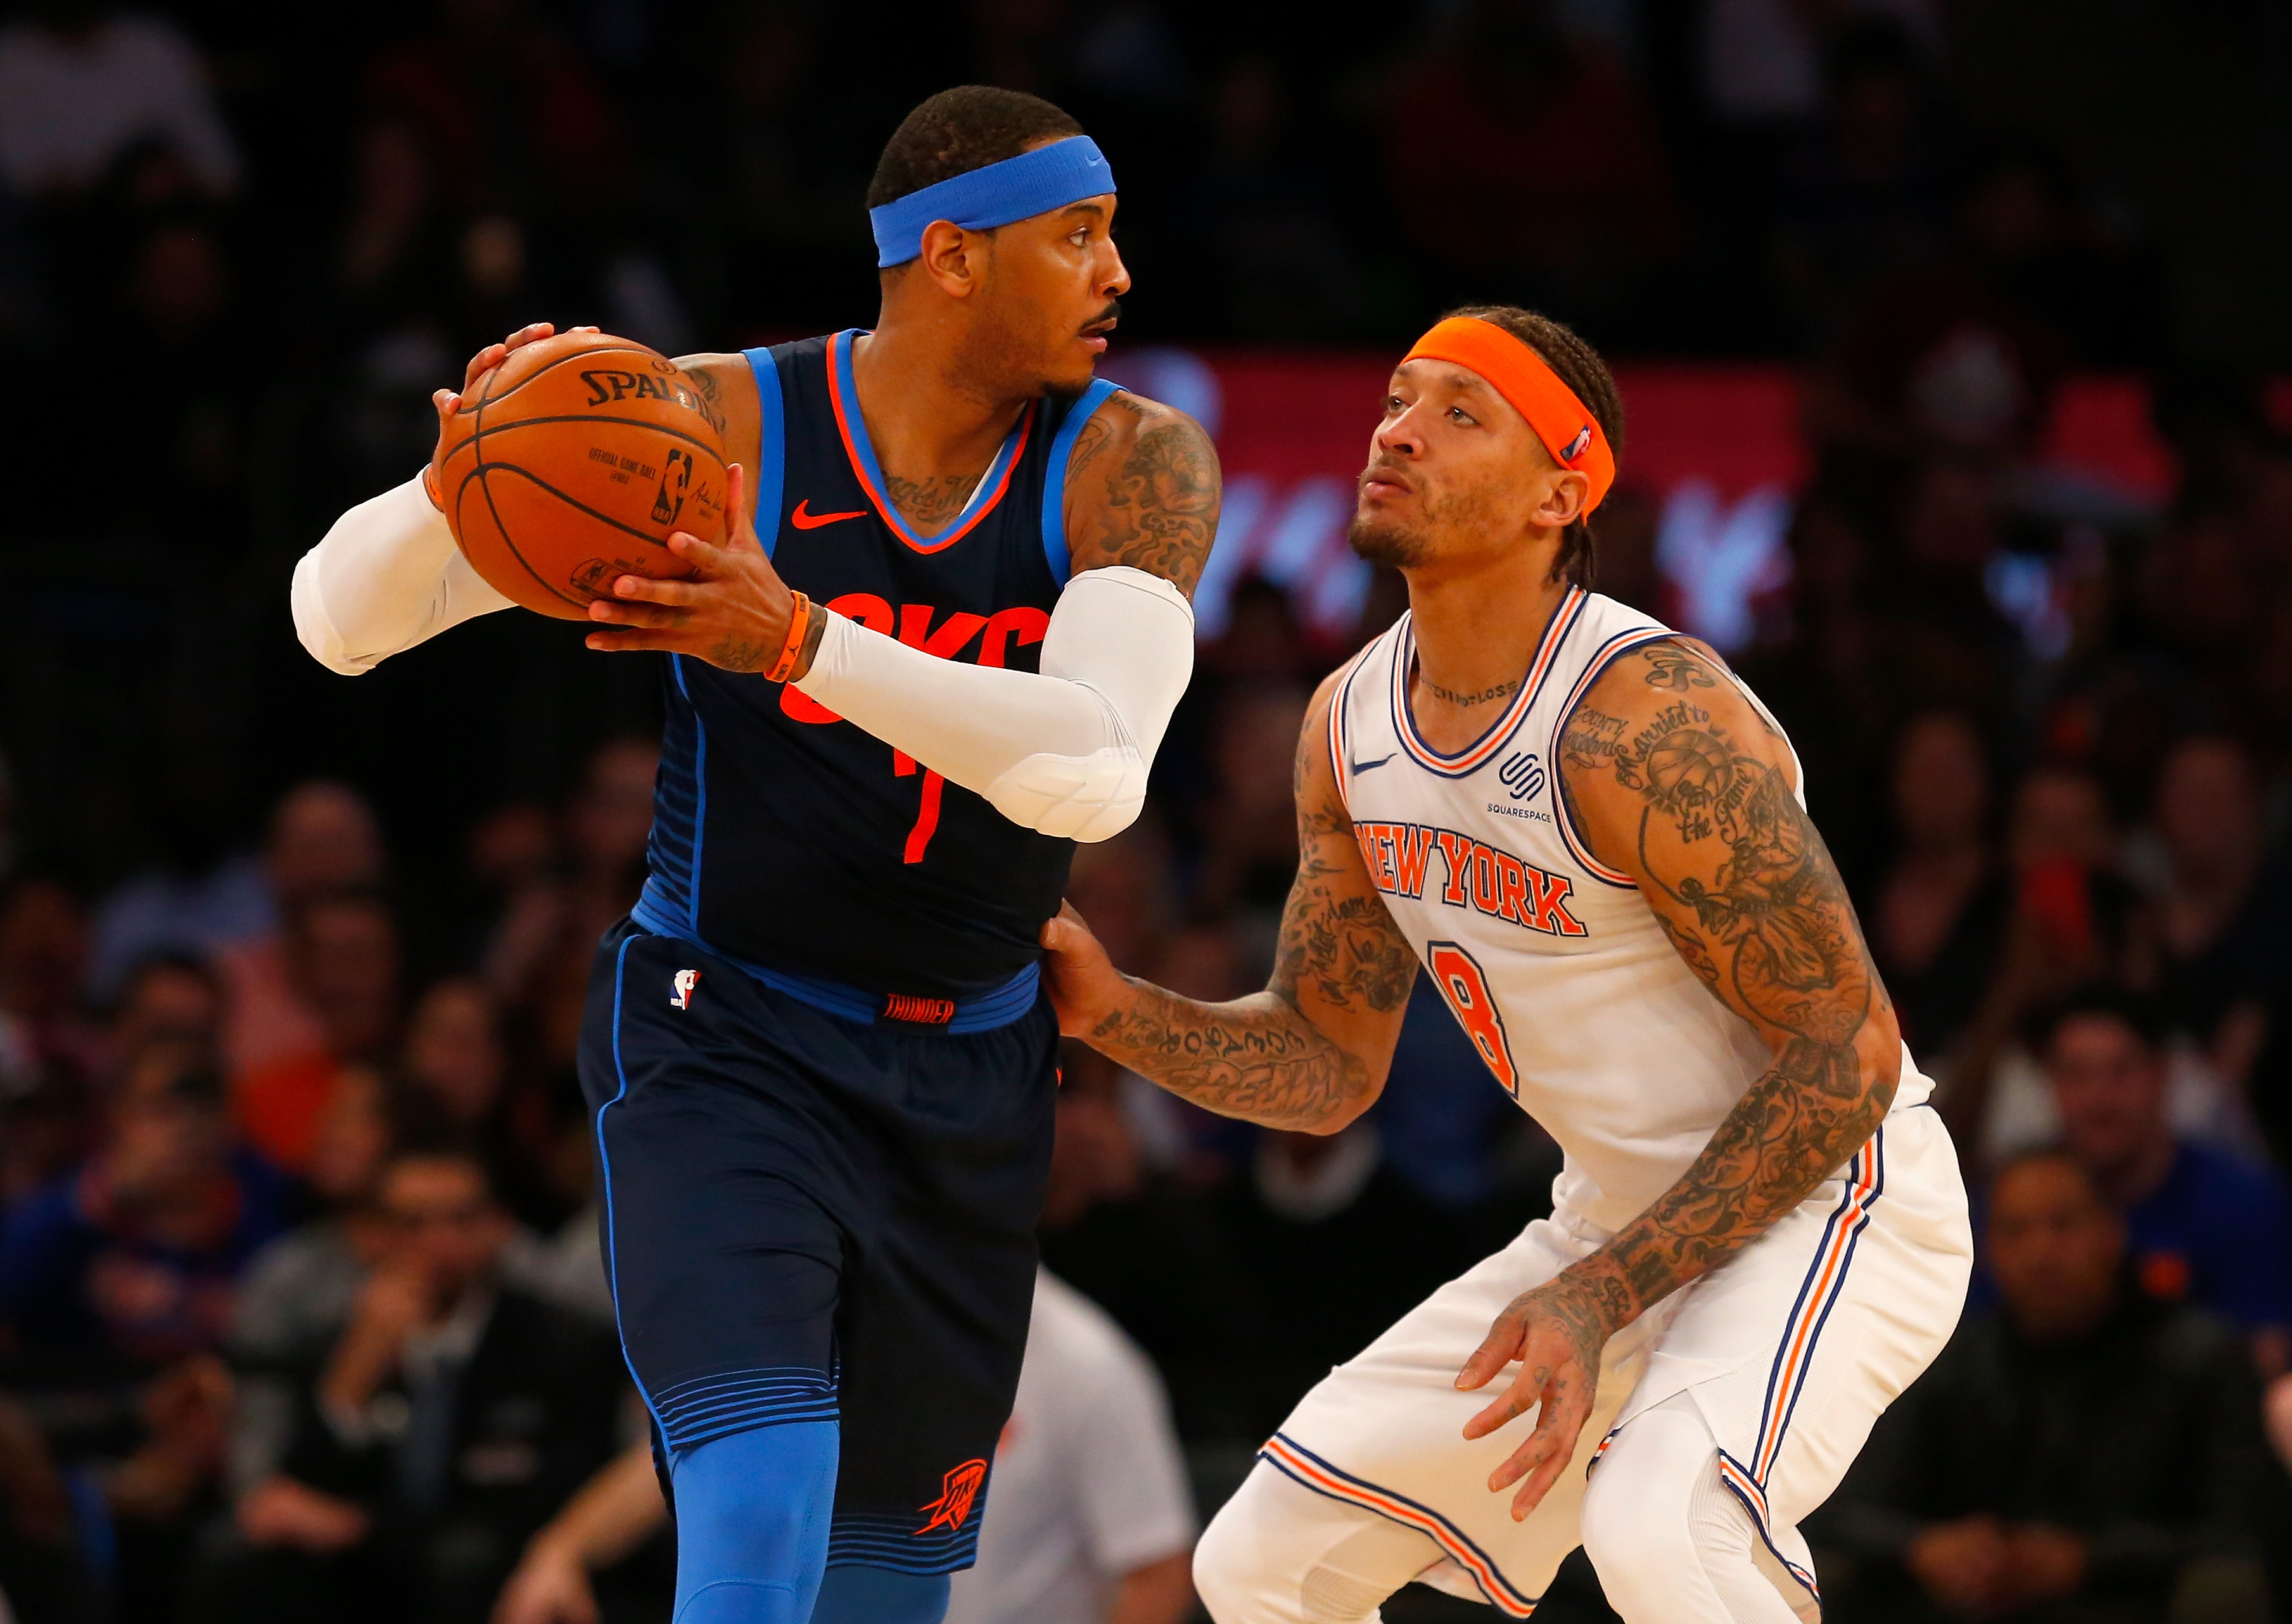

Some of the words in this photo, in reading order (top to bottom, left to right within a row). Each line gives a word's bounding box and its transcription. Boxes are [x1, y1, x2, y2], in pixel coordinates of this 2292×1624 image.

[1487, 803, 1551, 823] SQUARESPACE
[1353, 821, 1434, 900] NEW
[1436, 828, 1589, 937] YORK
[884, 993, 955, 1024] THUNDER
[1427, 941, 1519, 1100] 8
